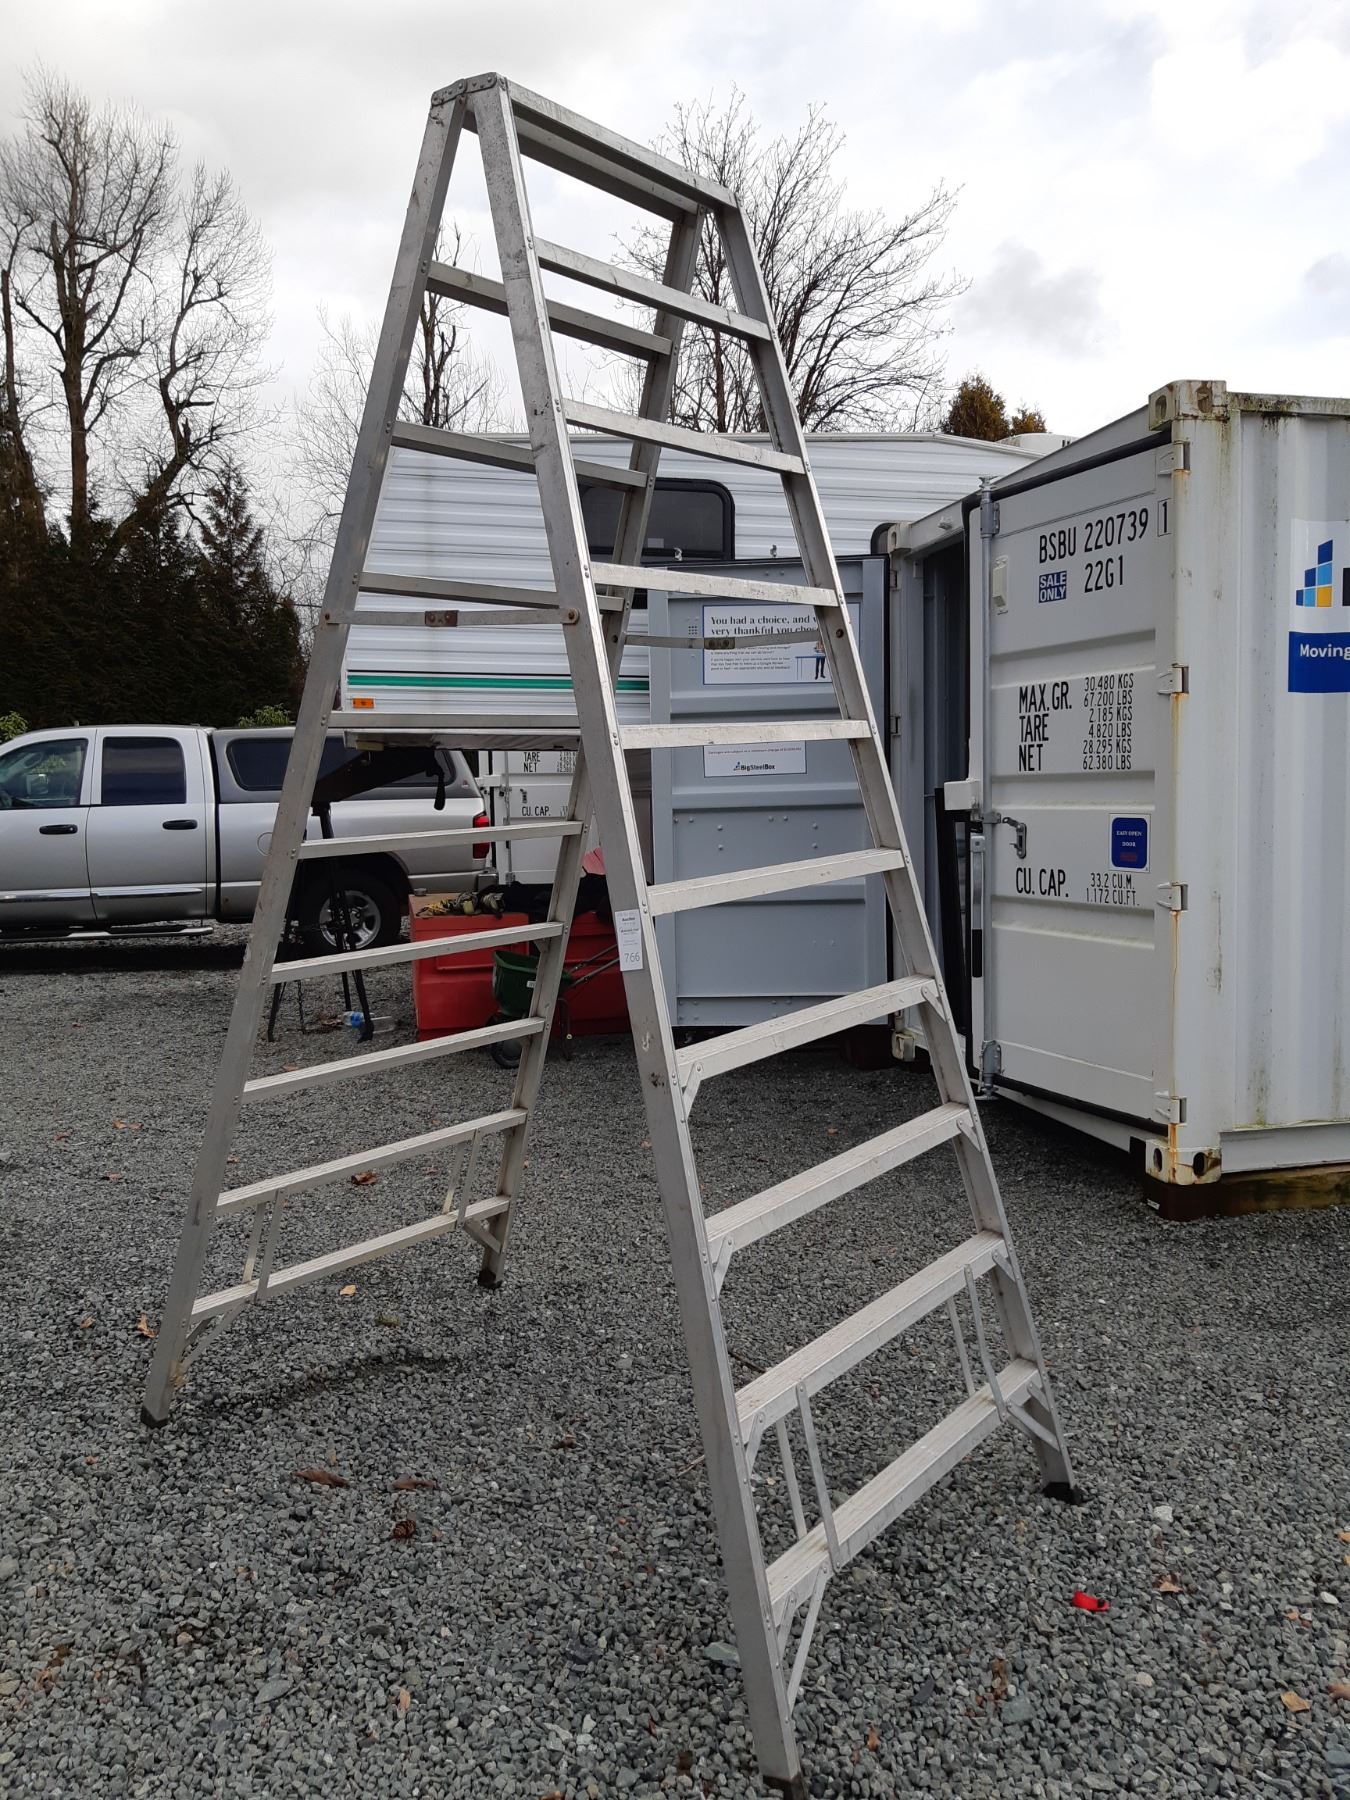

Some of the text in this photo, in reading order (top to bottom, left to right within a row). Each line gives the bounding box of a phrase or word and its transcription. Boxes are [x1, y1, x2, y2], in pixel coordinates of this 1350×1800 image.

[1039, 501, 1168, 564] BSBU 220739 1
[1039, 572, 1067, 588] SALE
[1084, 554, 1124, 593] 22G1
[1039, 586, 1066, 602] ONLY
[710, 616, 728, 625] You
[730, 616, 747, 625] had
[749, 617, 755, 625] a
[757, 615, 790, 626] choice,
[792, 615, 810, 624] and
[710, 626, 731, 636] very
[734, 625, 774, 636] thankful
[1084, 674, 1115, 692] 30.480
[1117, 672, 1134, 690] KGS
[1083, 689, 1133, 708] 67.200 LBS
[1018, 705, 1133, 743] TARE 2.185 KGS
[1088, 721, 1132, 739] 4.820 LBS
[523, 751, 541, 762] TARE
[1018, 738, 1132, 772] NET 28.295 KGS
[1082, 754, 1132, 771] 62.380 LBS
[523, 762, 538, 773] NET
[740, 763, 776, 772] BigSteelBox
[534, 805, 551, 817] CAP.
[1015, 867, 1035, 895] CU.
[1039, 868, 1069, 898] CAP.
[1090, 873, 1110, 888] 33.2
[1086, 887, 1110, 904] 1.172
[624, 951, 641, 963] 766
